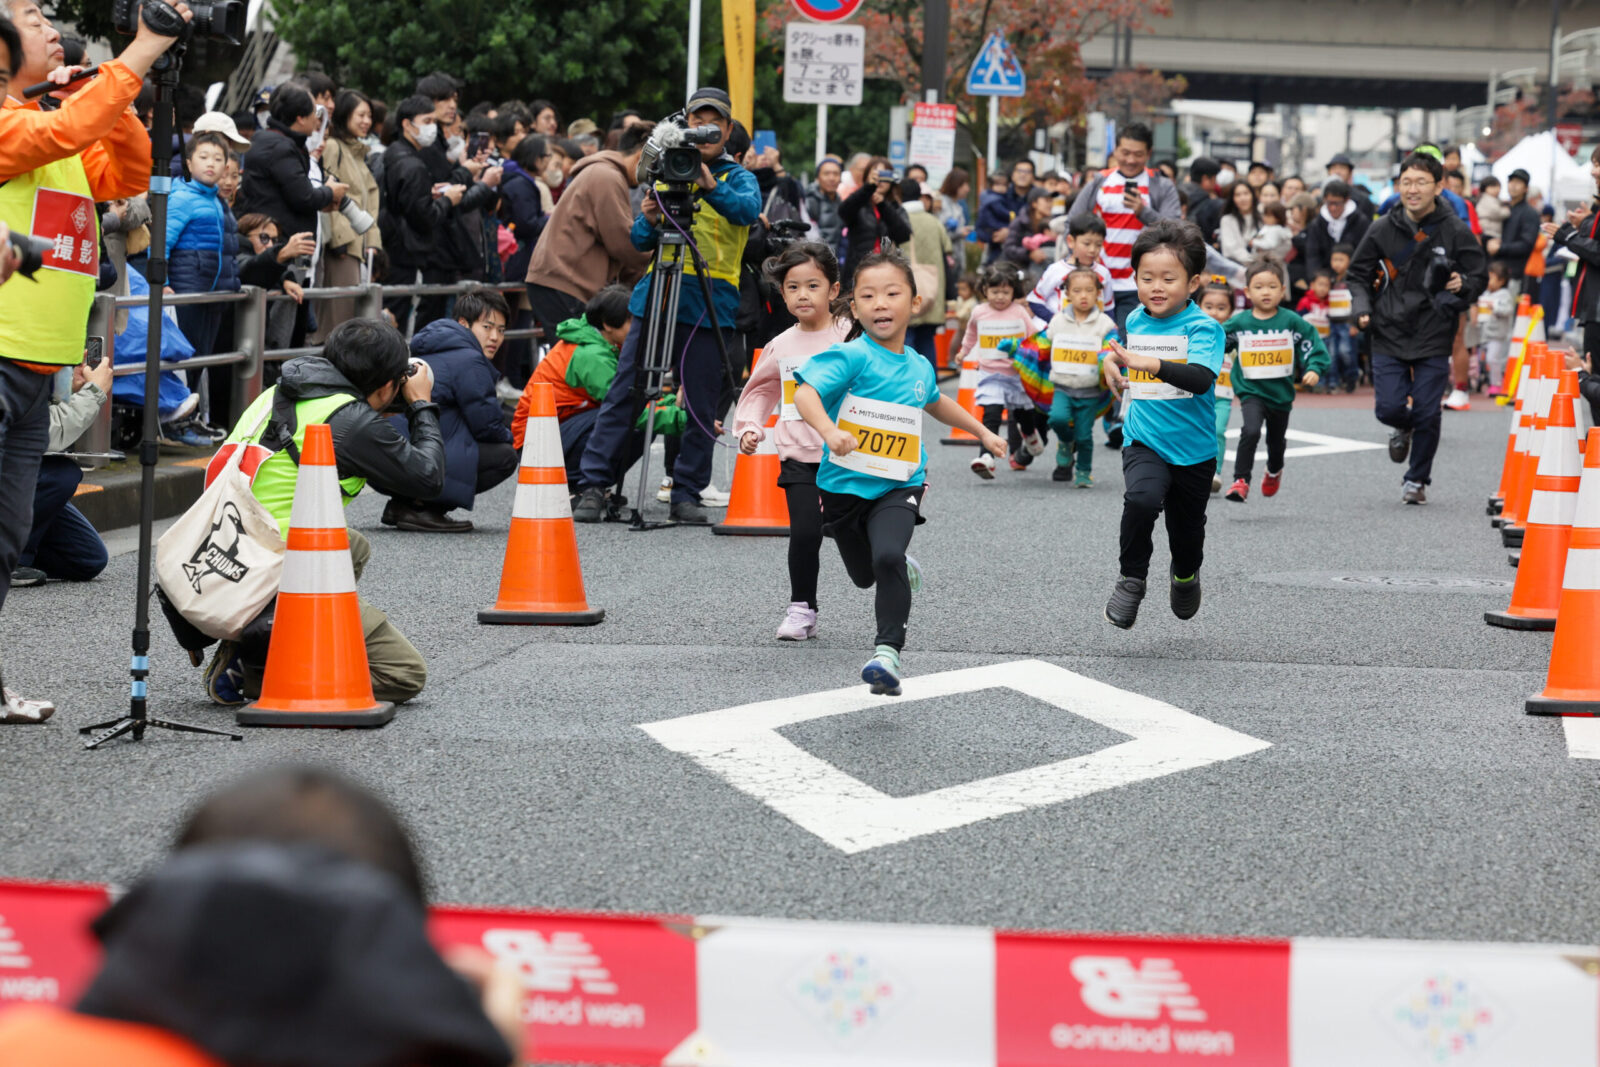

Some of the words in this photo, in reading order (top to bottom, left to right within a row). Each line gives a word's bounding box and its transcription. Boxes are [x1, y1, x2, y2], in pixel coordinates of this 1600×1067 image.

[792, 81, 855, 96] ここまで
[52, 233, 93, 264] 撮影
[1063, 350, 1088, 363] 7149
[1250, 352, 1282, 365] 7034
[859, 410, 896, 422] MITSUBISHI
[897, 417, 916, 425] MOTORS
[858, 429, 907, 457] 7077
[205, 547, 245, 580] CHUMS
